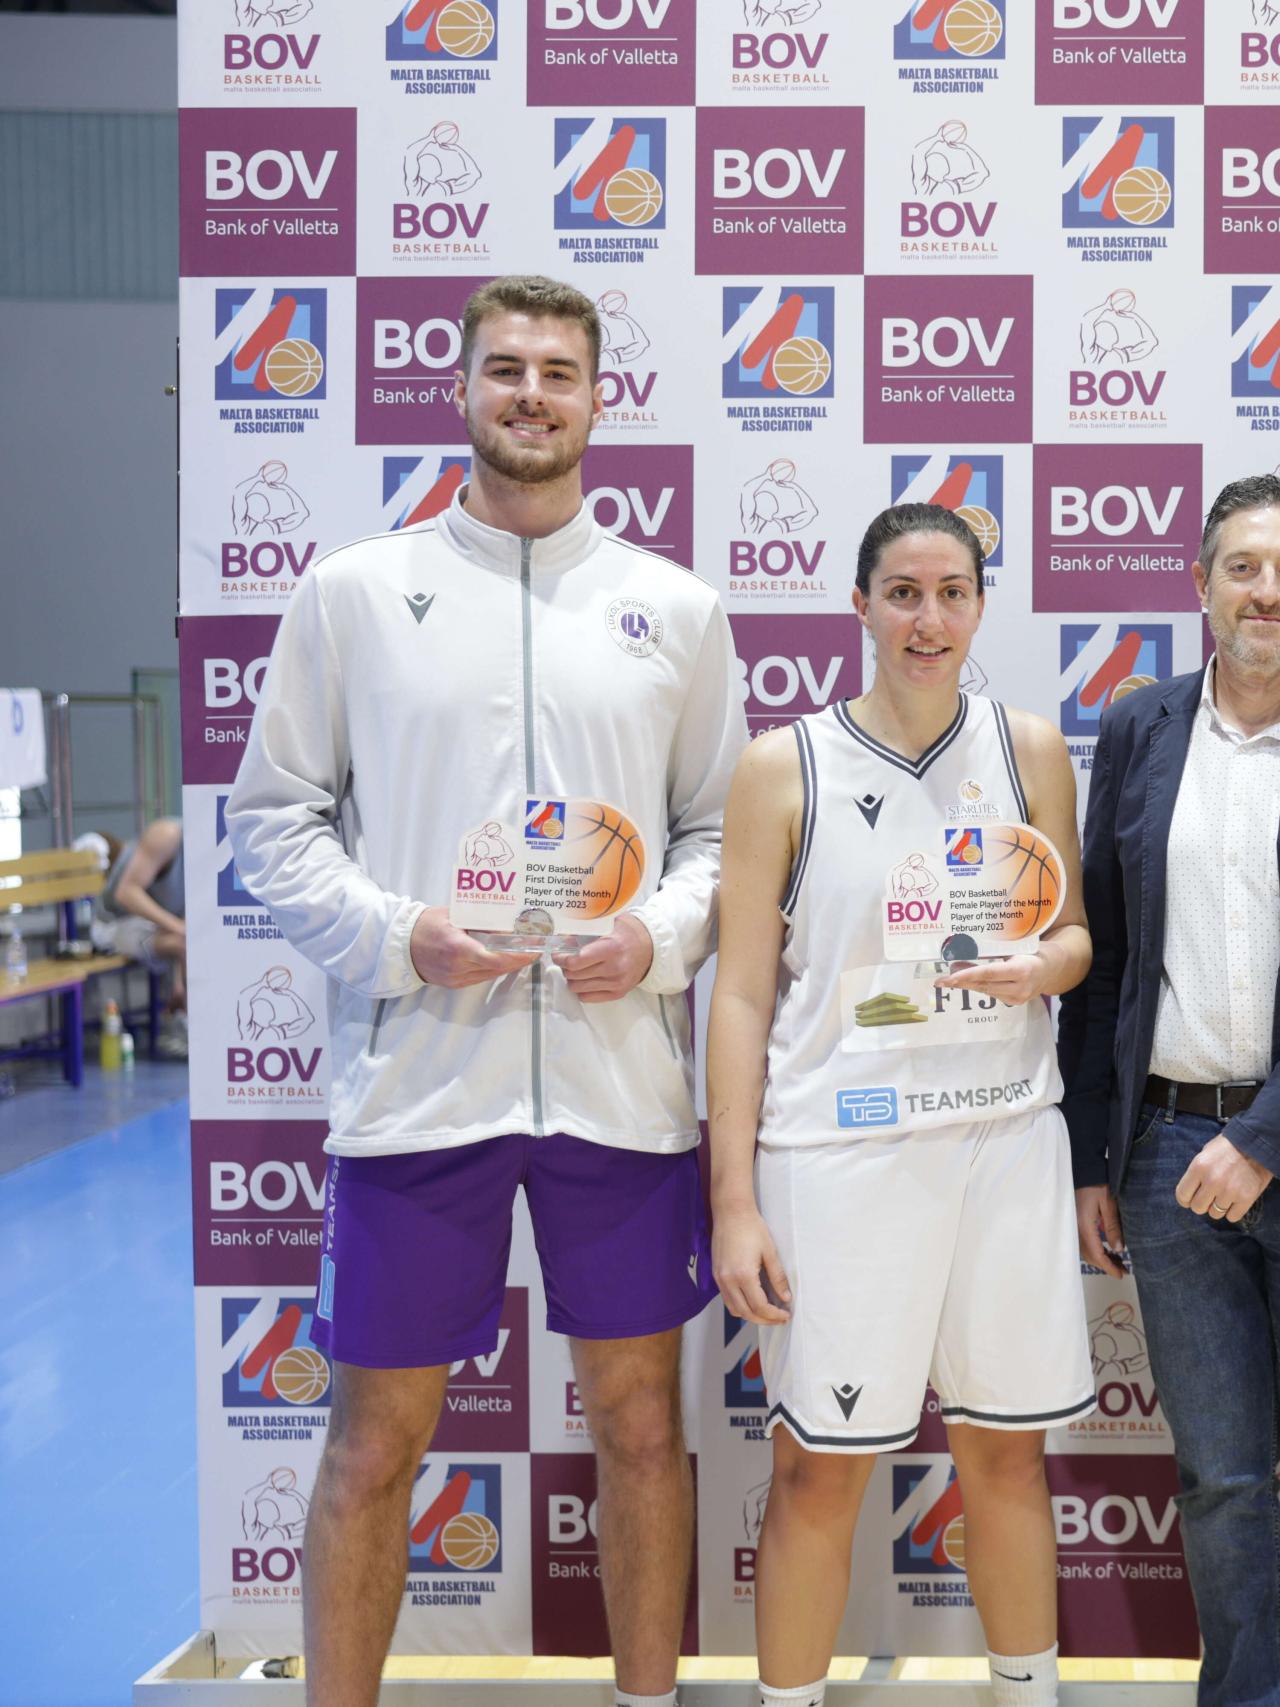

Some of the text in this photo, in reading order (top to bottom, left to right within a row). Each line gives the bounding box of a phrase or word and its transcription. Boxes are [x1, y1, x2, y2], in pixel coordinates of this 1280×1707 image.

[224, 33, 321, 70] BOV
[545, 48, 679, 65] Bank of Valletta
[224, 74, 322, 84] BASKETBALL
[390, 69, 491, 80] MALTA BASKETBALL
[405, 82, 476, 94] ASSOCIATION
[205, 150, 338, 201] BOV
[393, 202, 489, 238] BOV
[1221, 216, 1264, 232] Bank
[205, 218, 339, 235] Bank of Valletta
[393, 243, 490, 253] BASKETBALL
[1067, 237, 1168, 248] MALTA BASKETBALL
[1082, 250, 1153, 261] ASSOCIATION
[882, 316, 1015, 367] BOV
[881, 385, 1016, 402] Bank of Valletta
[1070, 369, 1166, 406] BOV
[219, 408, 319, 419] MALTA BASKETBALL
[1069, 410, 1167, 420] BASKETBALL
[234, 422, 304, 433] ASSOCIATION
[1050, 486, 1183, 536] BOV
[730, 540, 826, 576] BOV
[1050, 554, 1184, 571] Bank of Valletta
[729, 581, 827, 590] BASKETBALL
[620, 600, 655, 618] SPORTS
[652, 618, 661, 644] CLUB
[948, 803, 999, 816] STARLITES
[526, 864, 594, 875] BOV Basketball
[457, 869, 516, 892] BOV
[526, 875, 582, 885] First Division
[457, 892, 516, 901] BASKETBALL
[525, 887, 611, 898] Player of the Month
[950, 889, 1007, 899] BOV Basketball
[524, 898, 563, 909] February
[566, 900, 587, 909] 2023
[951, 901, 978, 909] Female
[980, 901, 1003, 911] Player
[1013, 899, 1026, 907] the
[1028, 899, 1051, 907] Month
[887, 900, 943, 922] BOV
[951, 913, 974, 922] Player
[976, 912, 985, 920] of
[999, 911, 1023, 919] Month
[889, 923, 945, 931] BASKETBALL
[951, 924, 985, 933] February
[986, 923, 1004, 931] 2023
[967, 1015, 999, 1024] GROUP
[227, 1047, 323, 1083] BOV
[227, 1087, 324, 1097] BASKETBALL
[904, 1079, 1034, 1113] TEAMSPORT
[210, 1161, 326, 1211] BOV
[210, 1229, 323, 1245] Bank of Valle
[228, 1415, 327, 1427] MALTA BASKETBALL
[242, 1429, 312, 1440] ASSOCIATION
[1051, 1495, 1178, 1544] BOV
[1095, 1562, 1114, 1578] of
[1117, 1562, 1183, 1579] Valletta
[407, 1581, 496, 1592] ALTA BASKETBALL
[411, 1594, 481, 1605] ASSOCIATION
